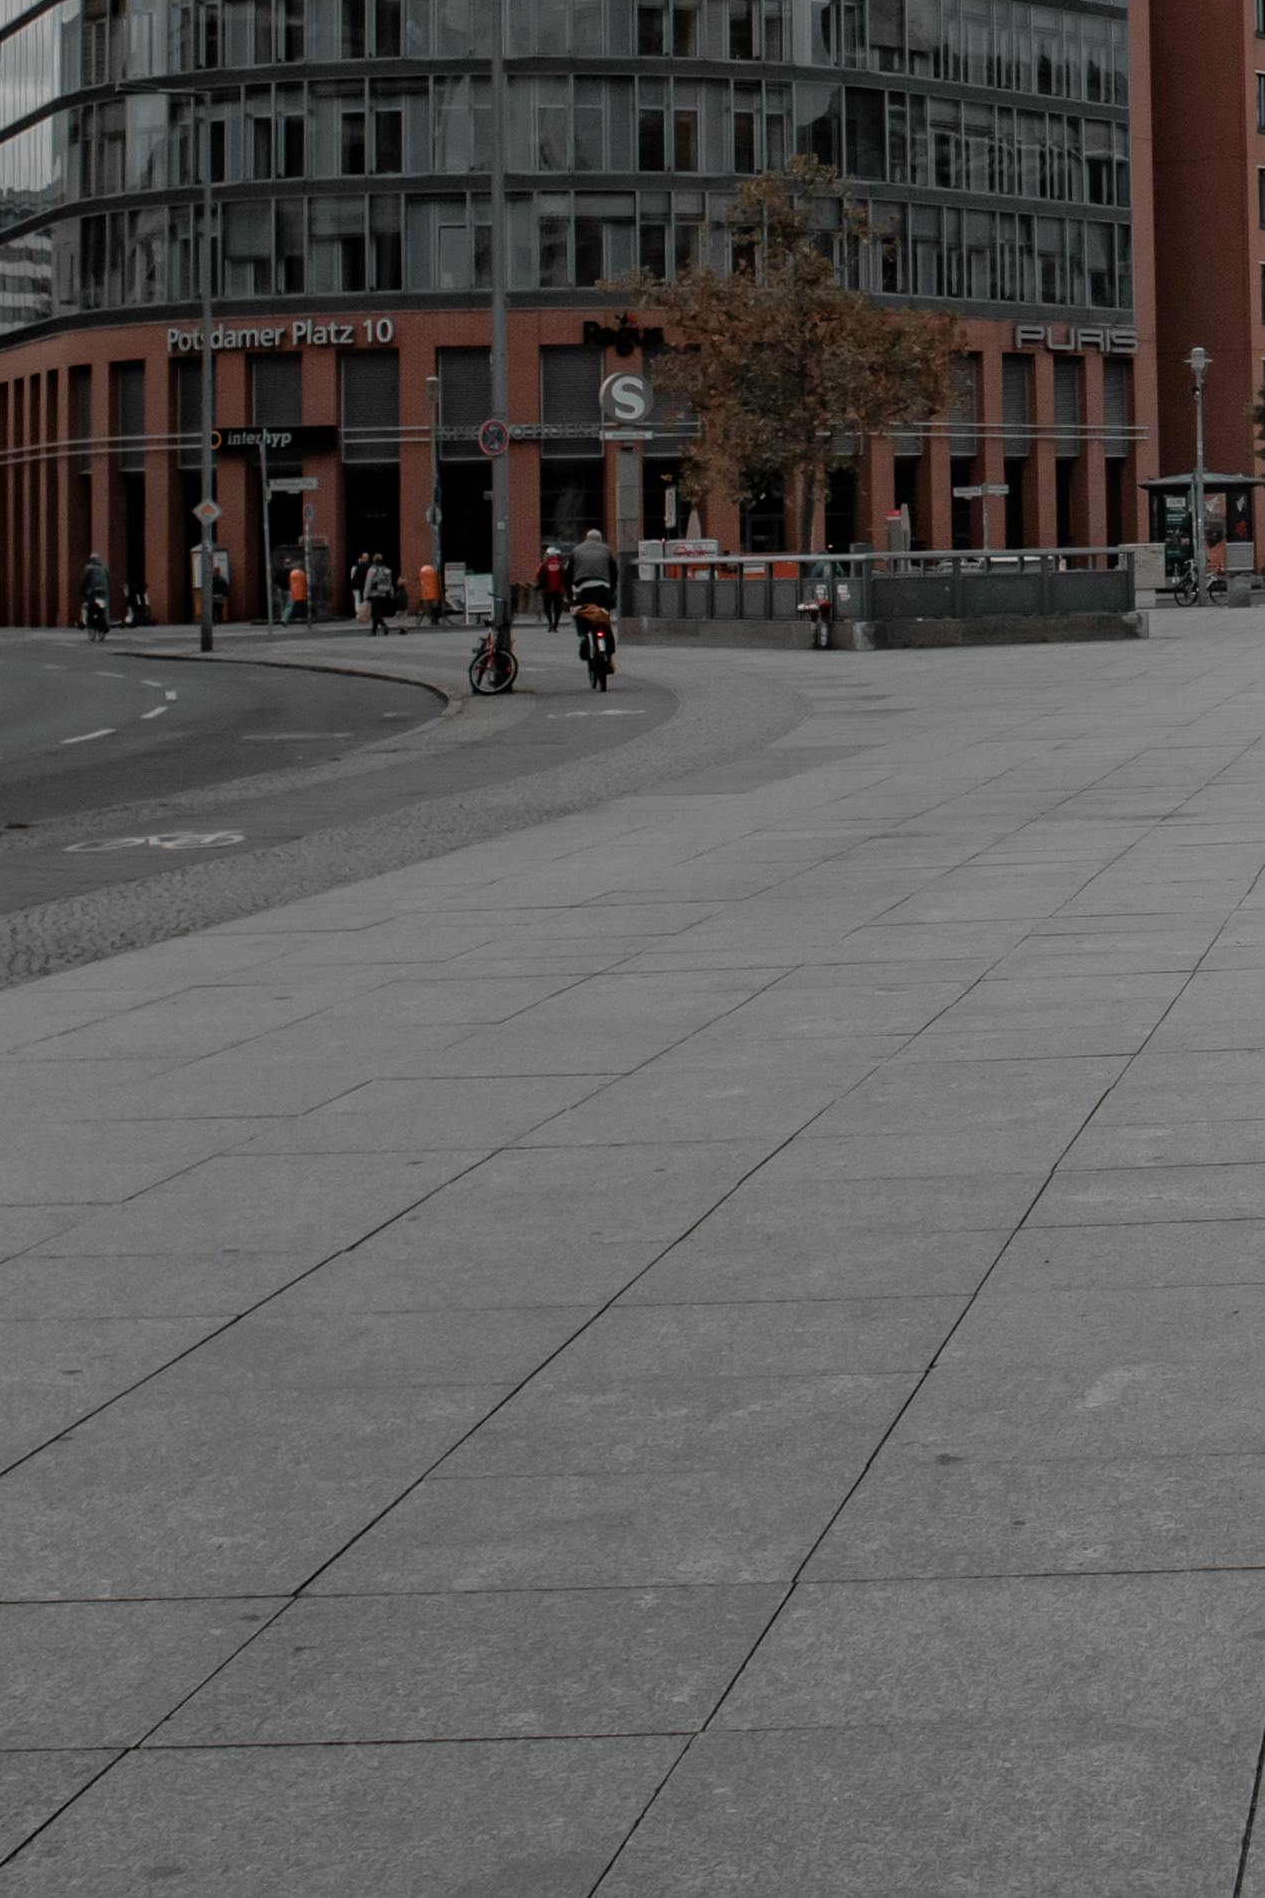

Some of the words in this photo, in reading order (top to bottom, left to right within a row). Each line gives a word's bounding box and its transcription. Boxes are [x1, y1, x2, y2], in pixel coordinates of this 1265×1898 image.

[292, 318, 354, 345] Platz
[363, 317, 395, 343] 10
[611, 375, 646, 420] S
